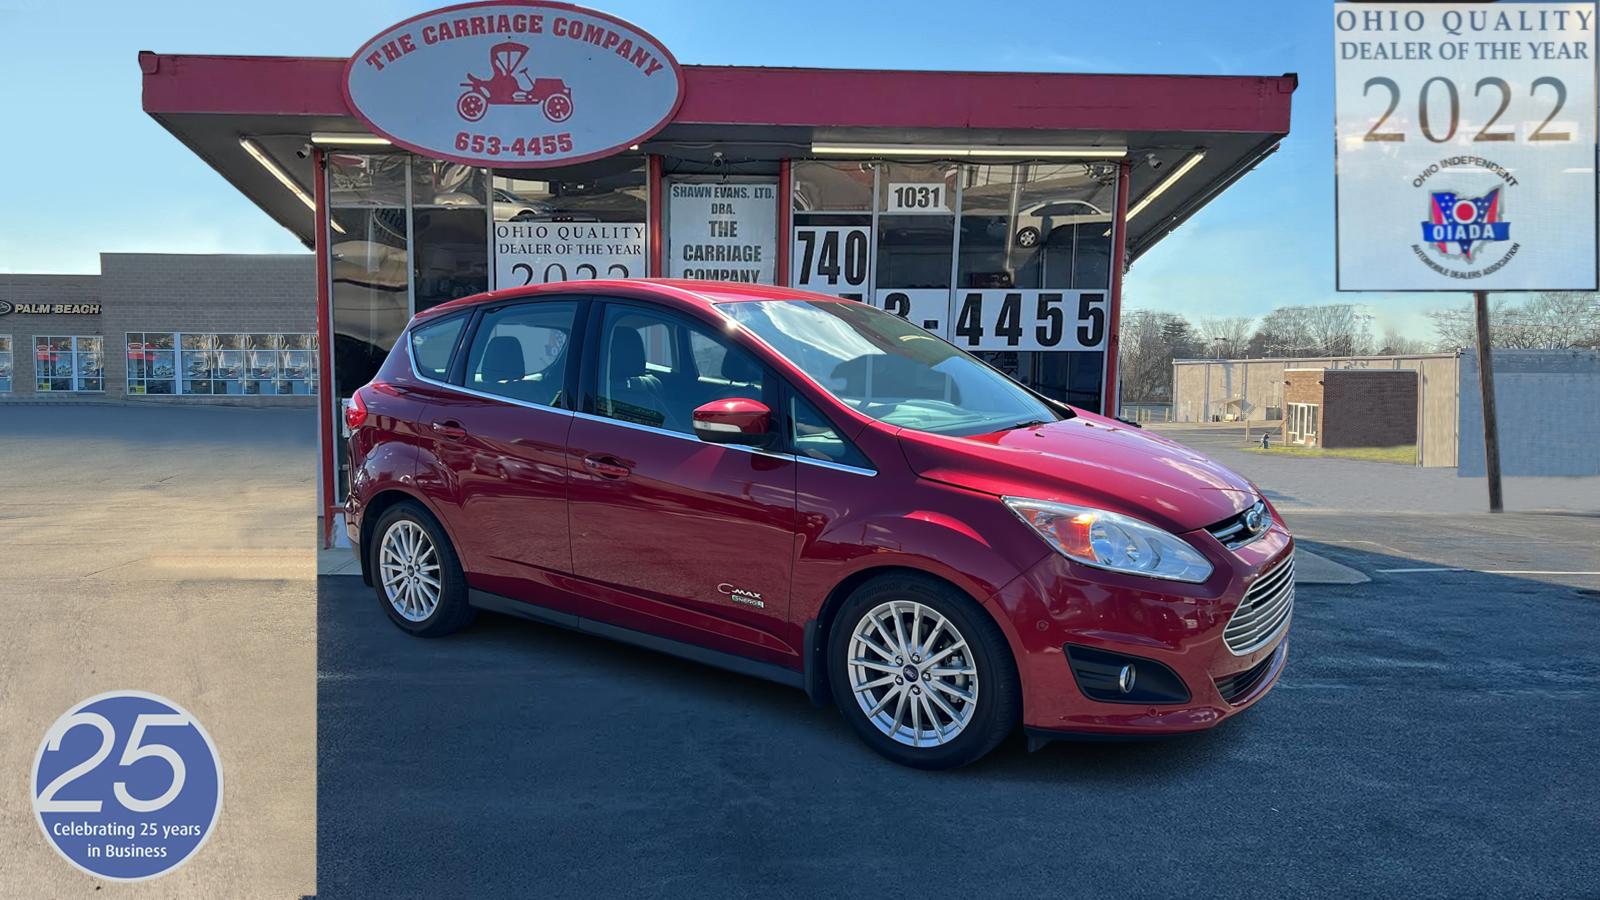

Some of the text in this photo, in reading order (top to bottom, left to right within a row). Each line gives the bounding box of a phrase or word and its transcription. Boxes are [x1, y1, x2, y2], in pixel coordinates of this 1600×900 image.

[1336, 10, 1593, 35] OHIO QUALITY
[365, 14, 664, 77] THE CARRIAGE COMPANY
[1340, 41, 1589, 60] DEALER OF THE YEAR
[1363, 76, 1571, 143] 2022
[455, 131, 573, 156] 653-4455
[1412, 155, 1519, 188] OHIO INDEPENDENT
[672, 185, 711, 198] SHAWN
[754, 187, 774, 200] LTD.
[895, 186, 940, 209] 1031
[711, 203, 736, 215] DBA.
[497, 226, 644, 240] OHIO QUALITY
[708, 220, 738, 238] THE
[1432, 224, 1495, 240] OIADA
[500, 243, 641, 255] DEALER OF THE YEAR
[683, 244, 762, 262] CARRIAGE
[797, 230, 868, 286] 740
[683, 268, 760, 283] COMPANY
[15, 303, 51, 314] PALM
